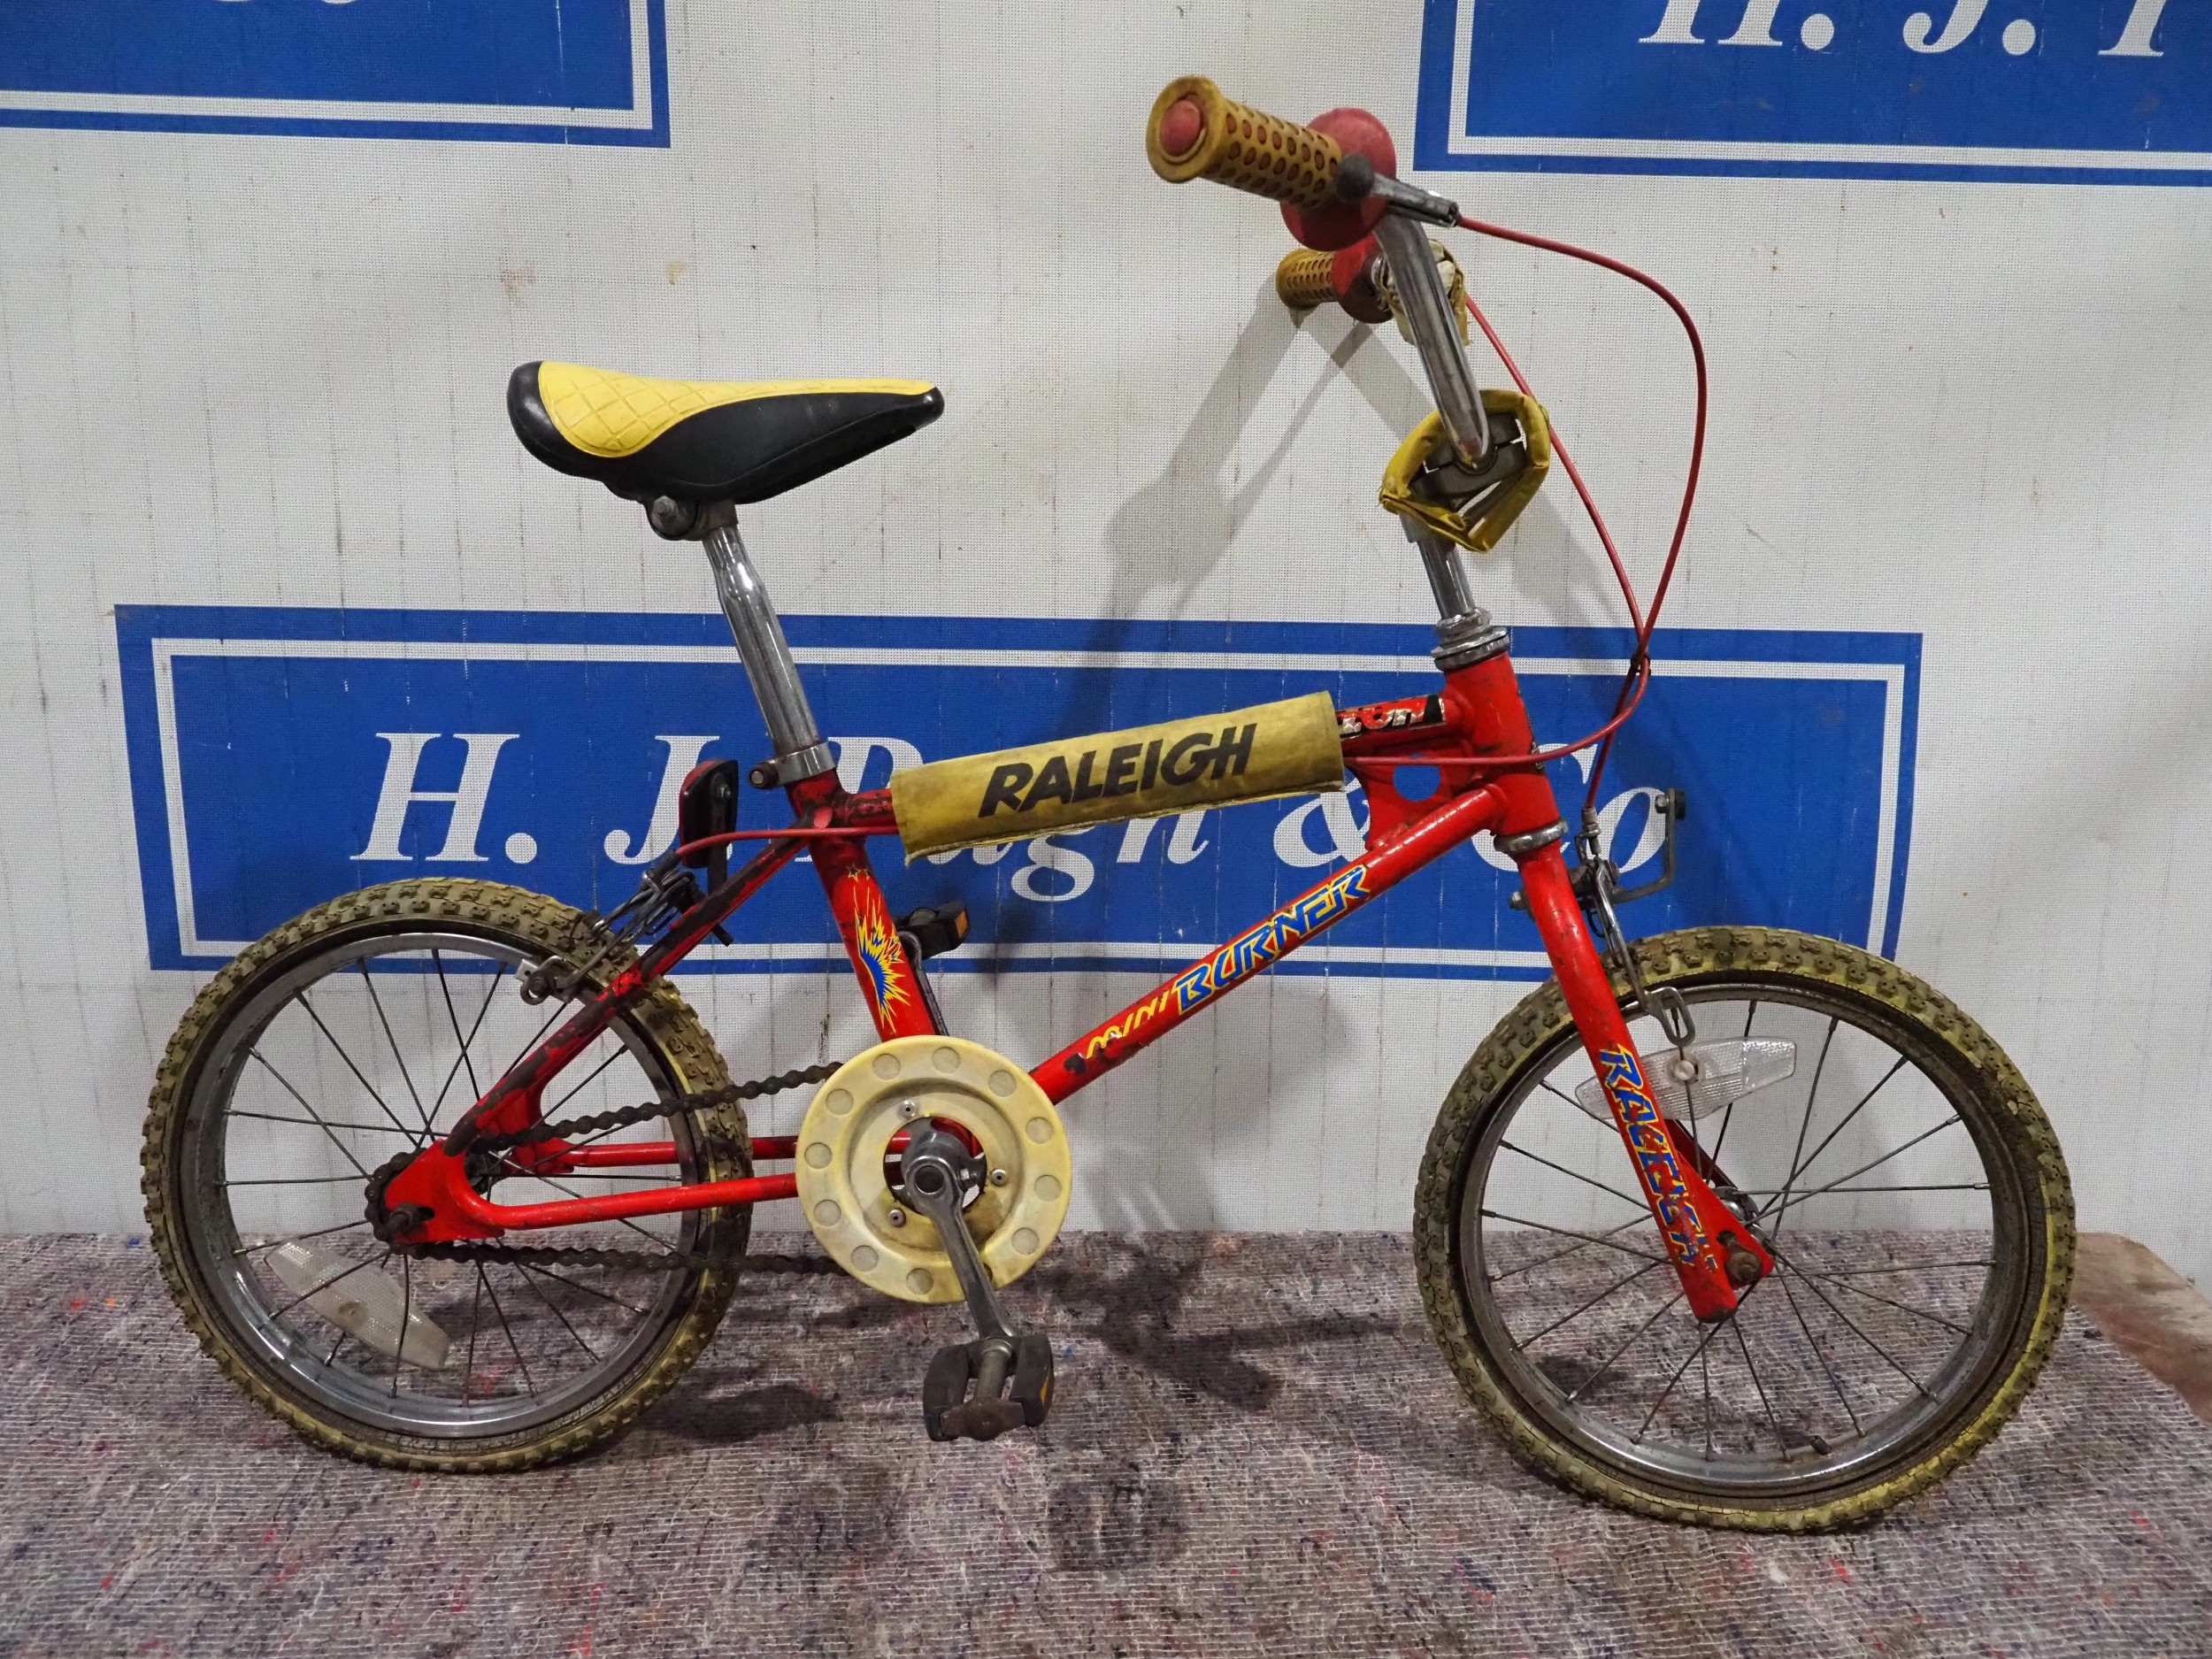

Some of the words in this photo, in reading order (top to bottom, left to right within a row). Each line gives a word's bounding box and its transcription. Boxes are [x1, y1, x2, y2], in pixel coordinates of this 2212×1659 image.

[350, 733, 538, 864] H.
[978, 722, 1256, 818] RALEIGH
[1171, 864, 1370, 1016] BURNER
